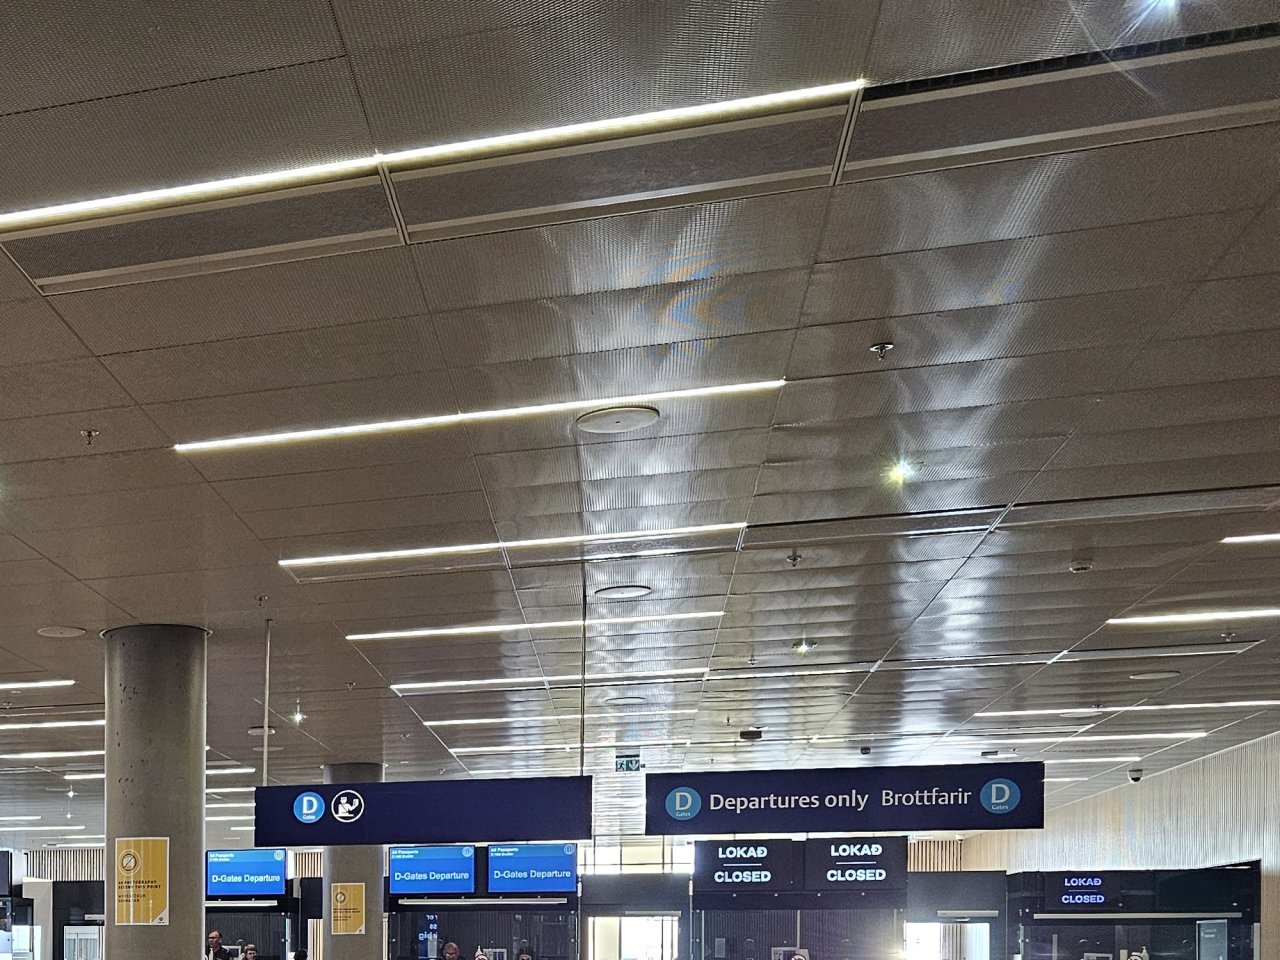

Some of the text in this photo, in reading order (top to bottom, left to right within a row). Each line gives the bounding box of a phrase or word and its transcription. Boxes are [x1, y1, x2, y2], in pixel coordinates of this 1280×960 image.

[991, 783, 1010, 803] D
[302, 796, 318, 814] D
[675, 792, 692, 811] D
[709, 787, 972, 814] Departures only Brottfarir
[718, 846, 768, 859] LOKAÐ
[830, 844, 883, 857] LOKAÐ
[212, 874, 281, 884] D-Gates Departure
[394, 871, 469, 881] D-Gates Departure
[493, 869, 571, 879] D-Gates Departure
[714, 870, 772, 883] CLOSED
[826, 869, 887, 881] CLOSED
[1064, 877, 1102, 887] LOKAÐ
[1061, 894, 1105, 904] CLOSED
